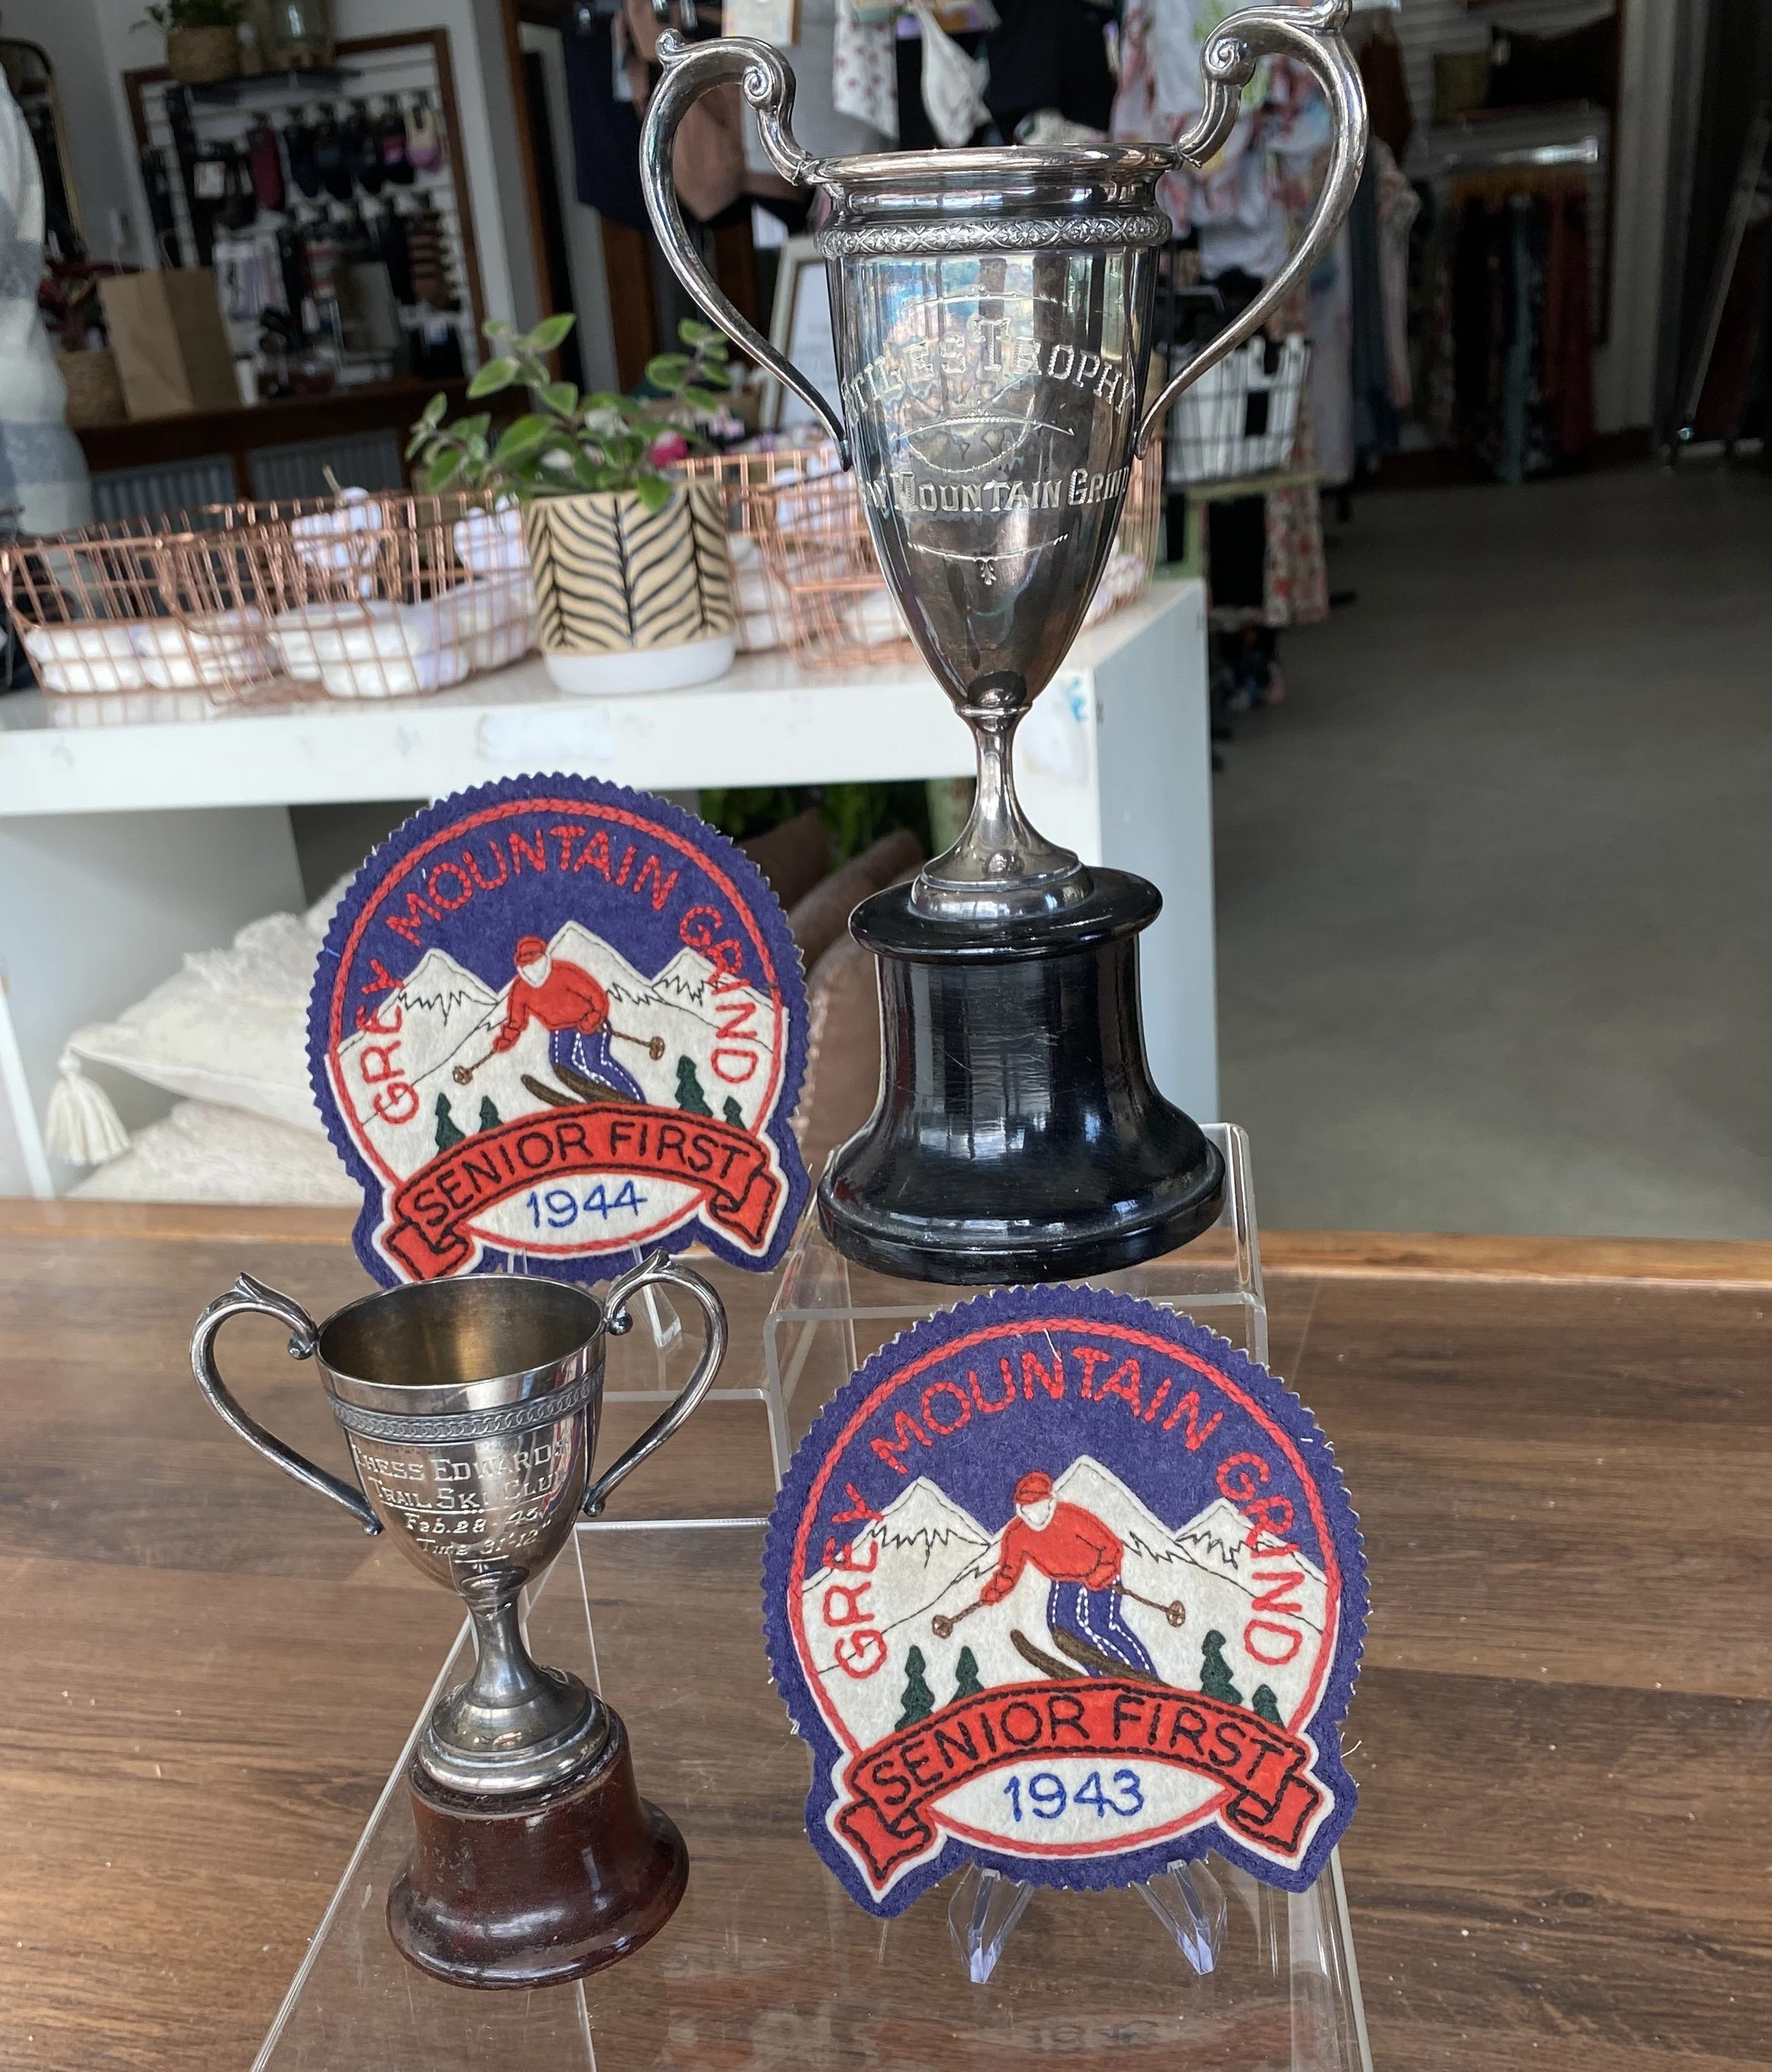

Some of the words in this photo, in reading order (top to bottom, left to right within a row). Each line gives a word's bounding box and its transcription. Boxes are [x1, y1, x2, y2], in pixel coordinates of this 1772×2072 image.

[971, 317, 1135, 414] TROPHY
[890, 471, 1063, 512] MOUNTAIN
[385, 825, 679, 947] MOUNTAIN
[358, 958, 420, 1127] GREY
[678, 905, 759, 1085] GRIND
[413, 1122, 593, 1227] SENIOR
[609, 1120, 750, 1179] FIRST
[526, 1180, 647, 1229] 1944
[367, 1475, 433, 1509] TRAIL
[435, 1487, 490, 1509] SKI
[820, 1482, 888, 1681] GREY
[871, 1346, 1225, 1475] MOUNTAIN
[1216, 1453, 1305, 1667] GRIND
[871, 1694, 1089, 1806] SENIOR
[1112, 1695, 1280, 1781] FIRST
[1003, 1768, 1147, 1822] 1943
